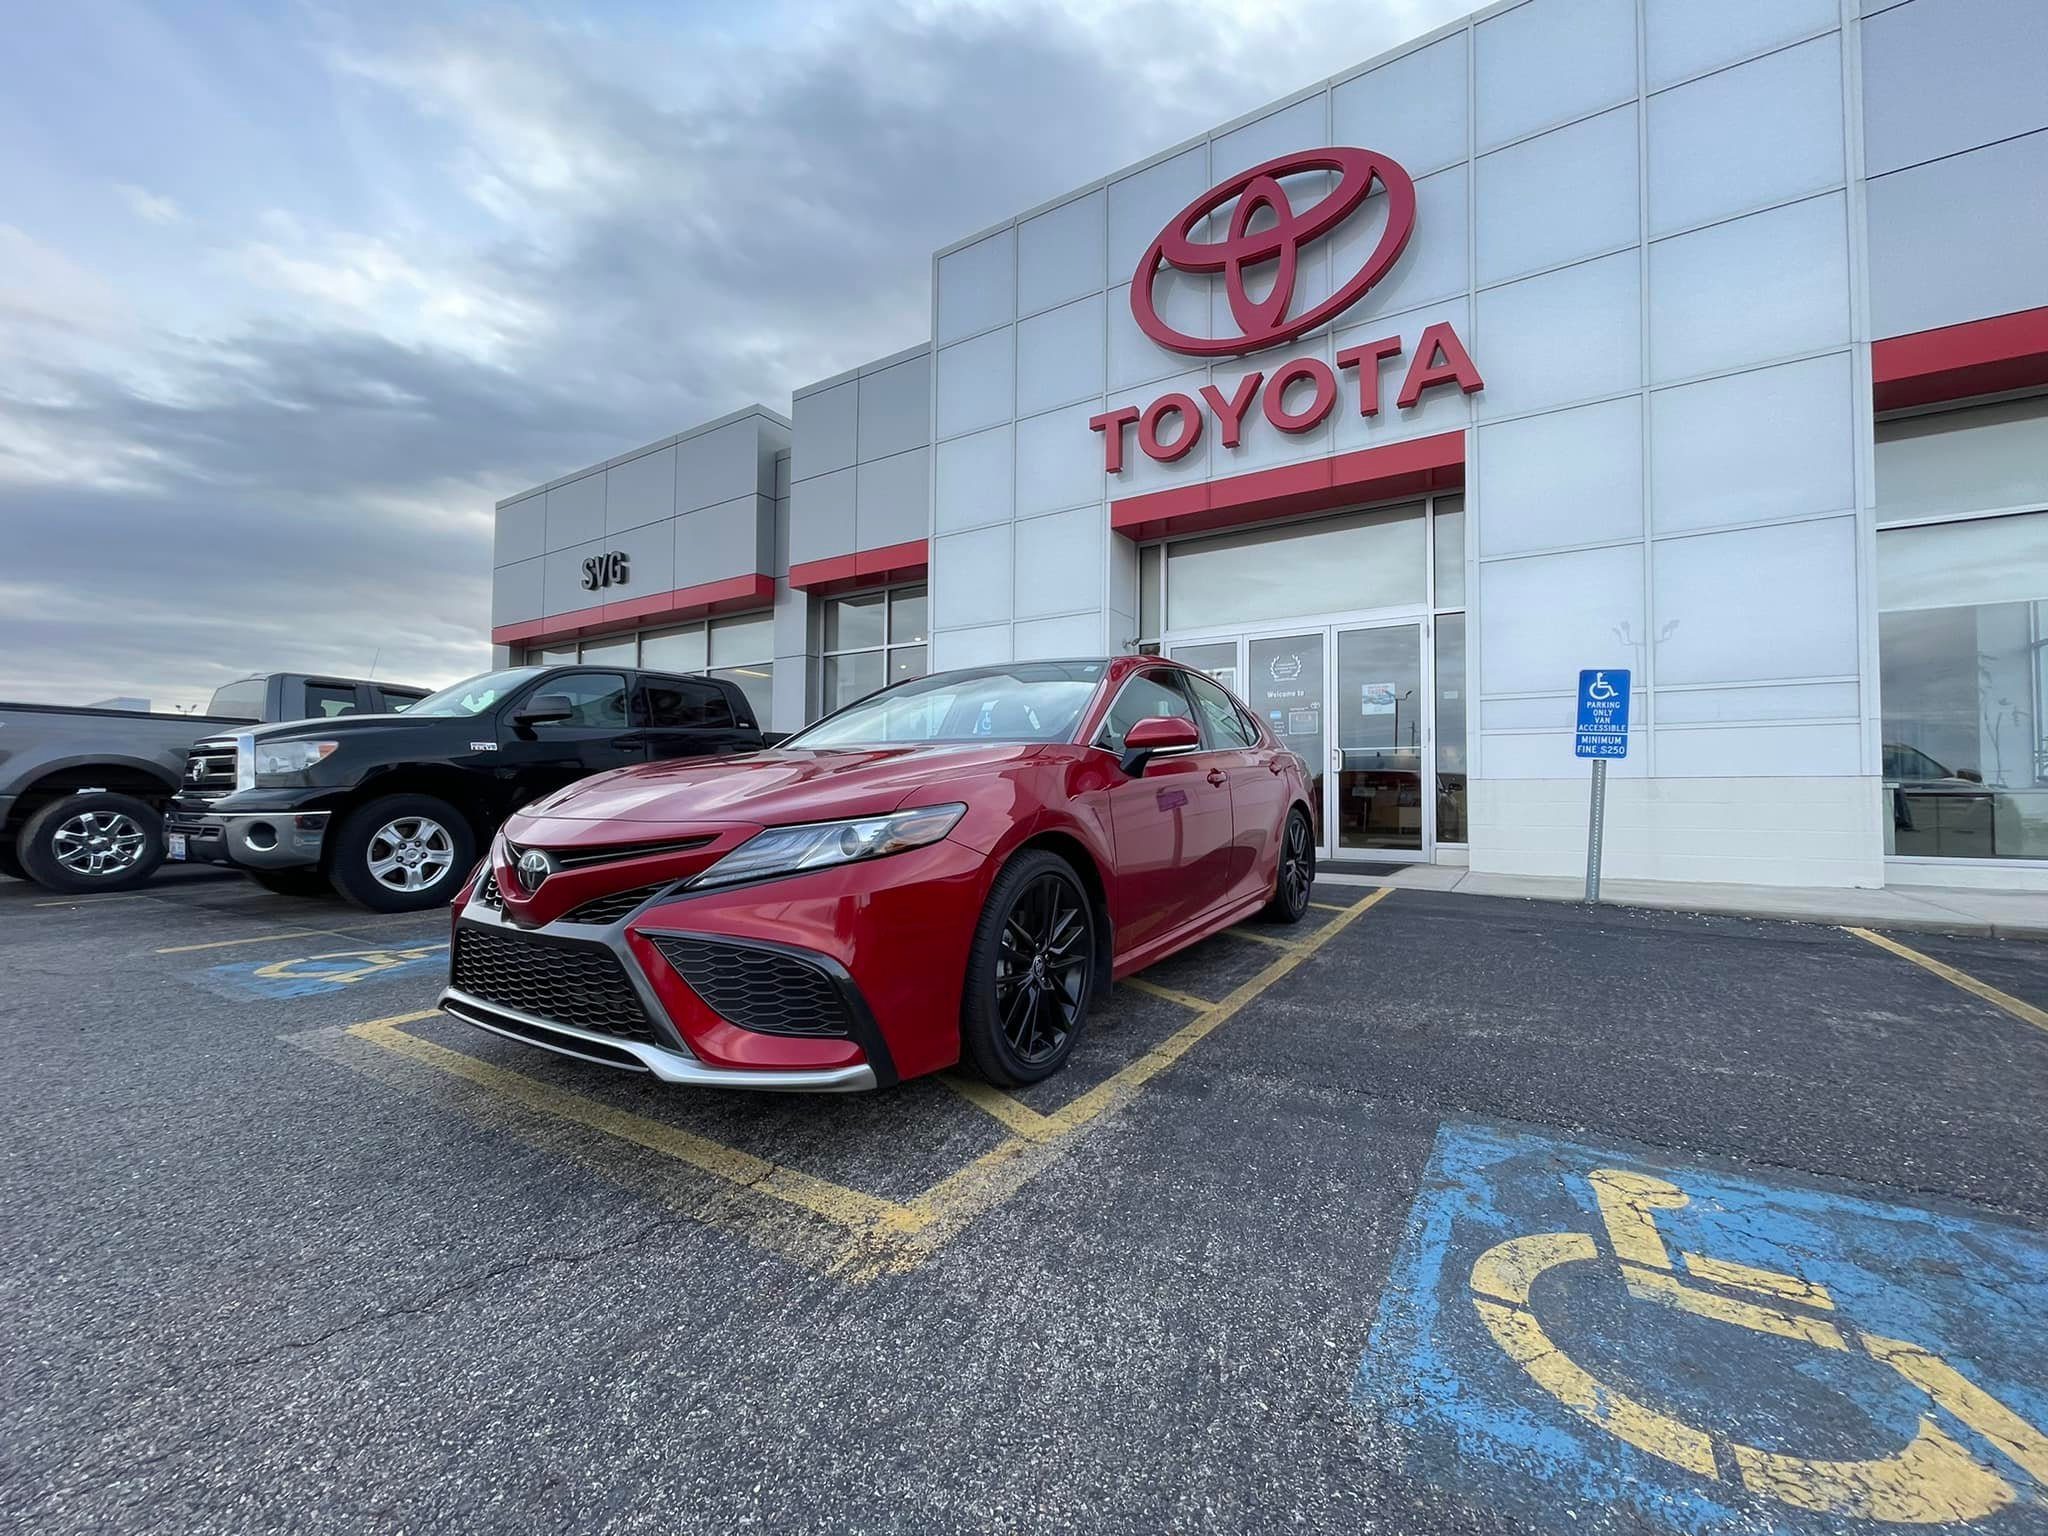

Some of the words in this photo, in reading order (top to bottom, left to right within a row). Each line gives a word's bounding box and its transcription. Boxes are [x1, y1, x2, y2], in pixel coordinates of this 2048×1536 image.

[1089, 321, 1484, 473] TOYOTA
[581, 551, 627, 590] SVG
[1267, 690, 1296, 698] Welcome
[1579, 724, 1627, 732] ACCESSIBLE
[1582, 736, 1622, 745] MINIMUM
[1577, 745, 1597, 753] FINE
